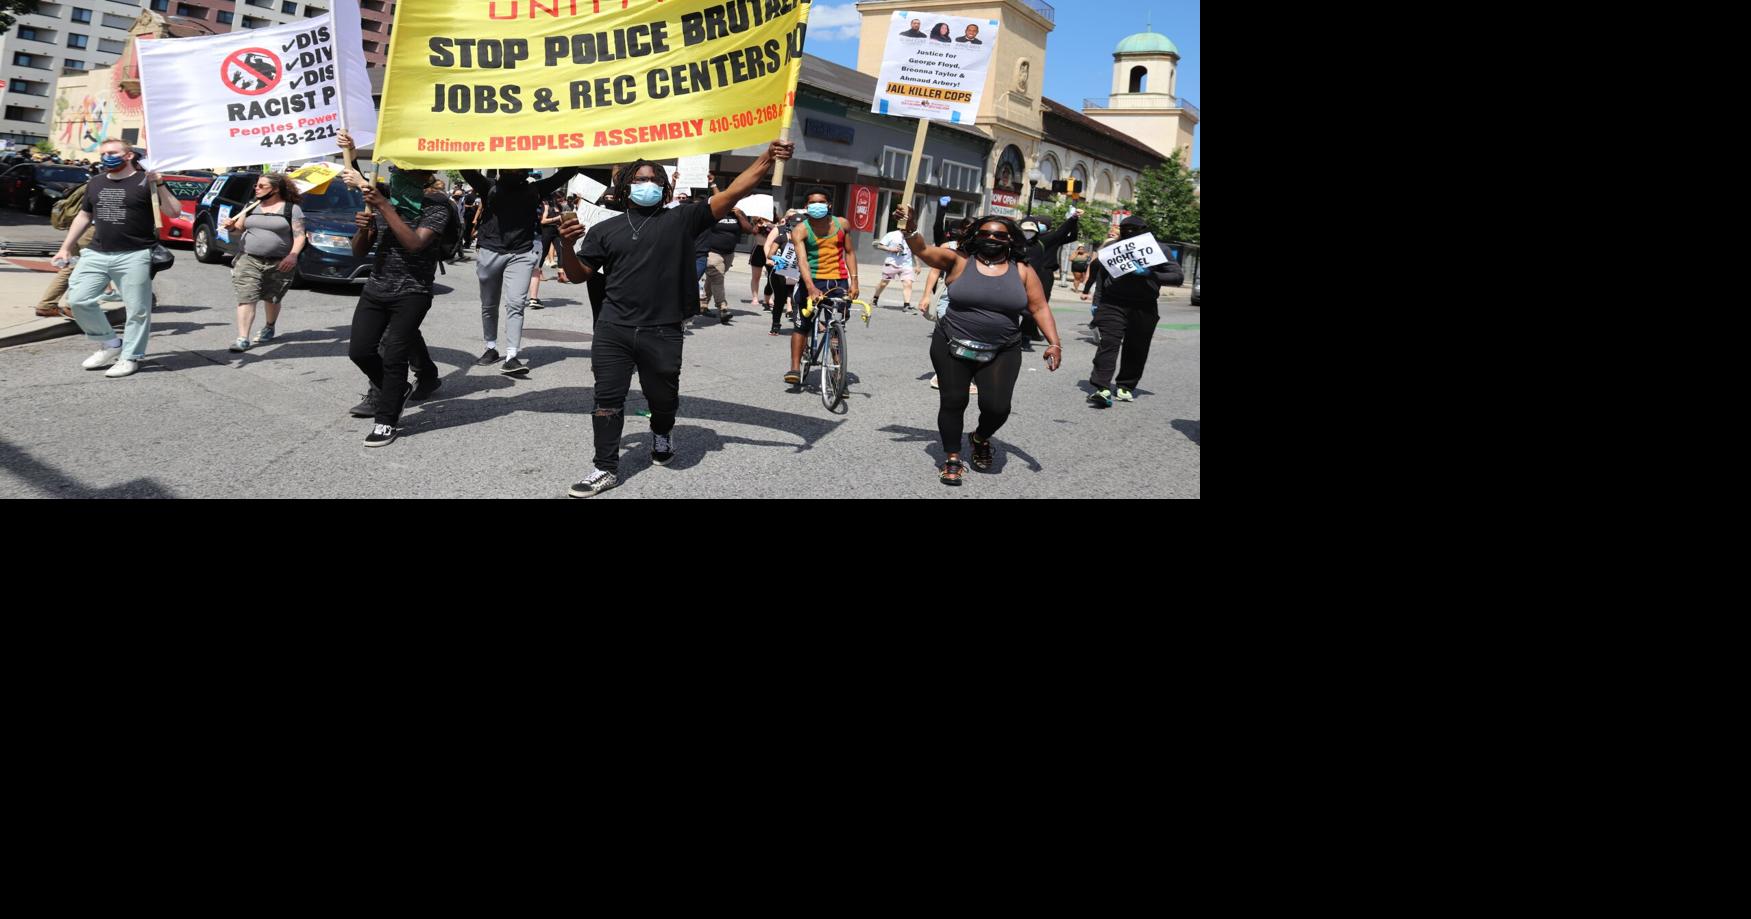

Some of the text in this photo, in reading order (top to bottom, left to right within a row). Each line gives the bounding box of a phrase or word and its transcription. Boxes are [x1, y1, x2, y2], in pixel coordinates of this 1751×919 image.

[296, 26, 331, 49] DIS
[429, 37, 529, 69] STOP
[545, 20, 669, 66] POLICE
[908, 58, 960, 69] George Floyd,
[917, 49, 944, 58] Justice
[431, 83, 523, 113] JOBS
[533, 87, 560, 112] &
[570, 75, 637, 110] REC
[647, 39, 781, 99] CENTERS
[900, 75, 960, 88] Ahmaud Arbery!
[901, 66, 933, 75] Breonna
[935, 70, 958, 79] Taylor
[886, 83, 972, 103] JAIL KILLER COPS
[227, 90, 317, 121] RACIST
[229, 113, 337, 137] Peoples Power
[417, 137, 486, 152] Baltimore
[489, 132, 585, 152] PEOPLES
[593, 118, 704, 149] ASSEMBLY
[1106, 246, 1153, 267] RIGHT TO
[1113, 242, 1136, 256] IT IS
